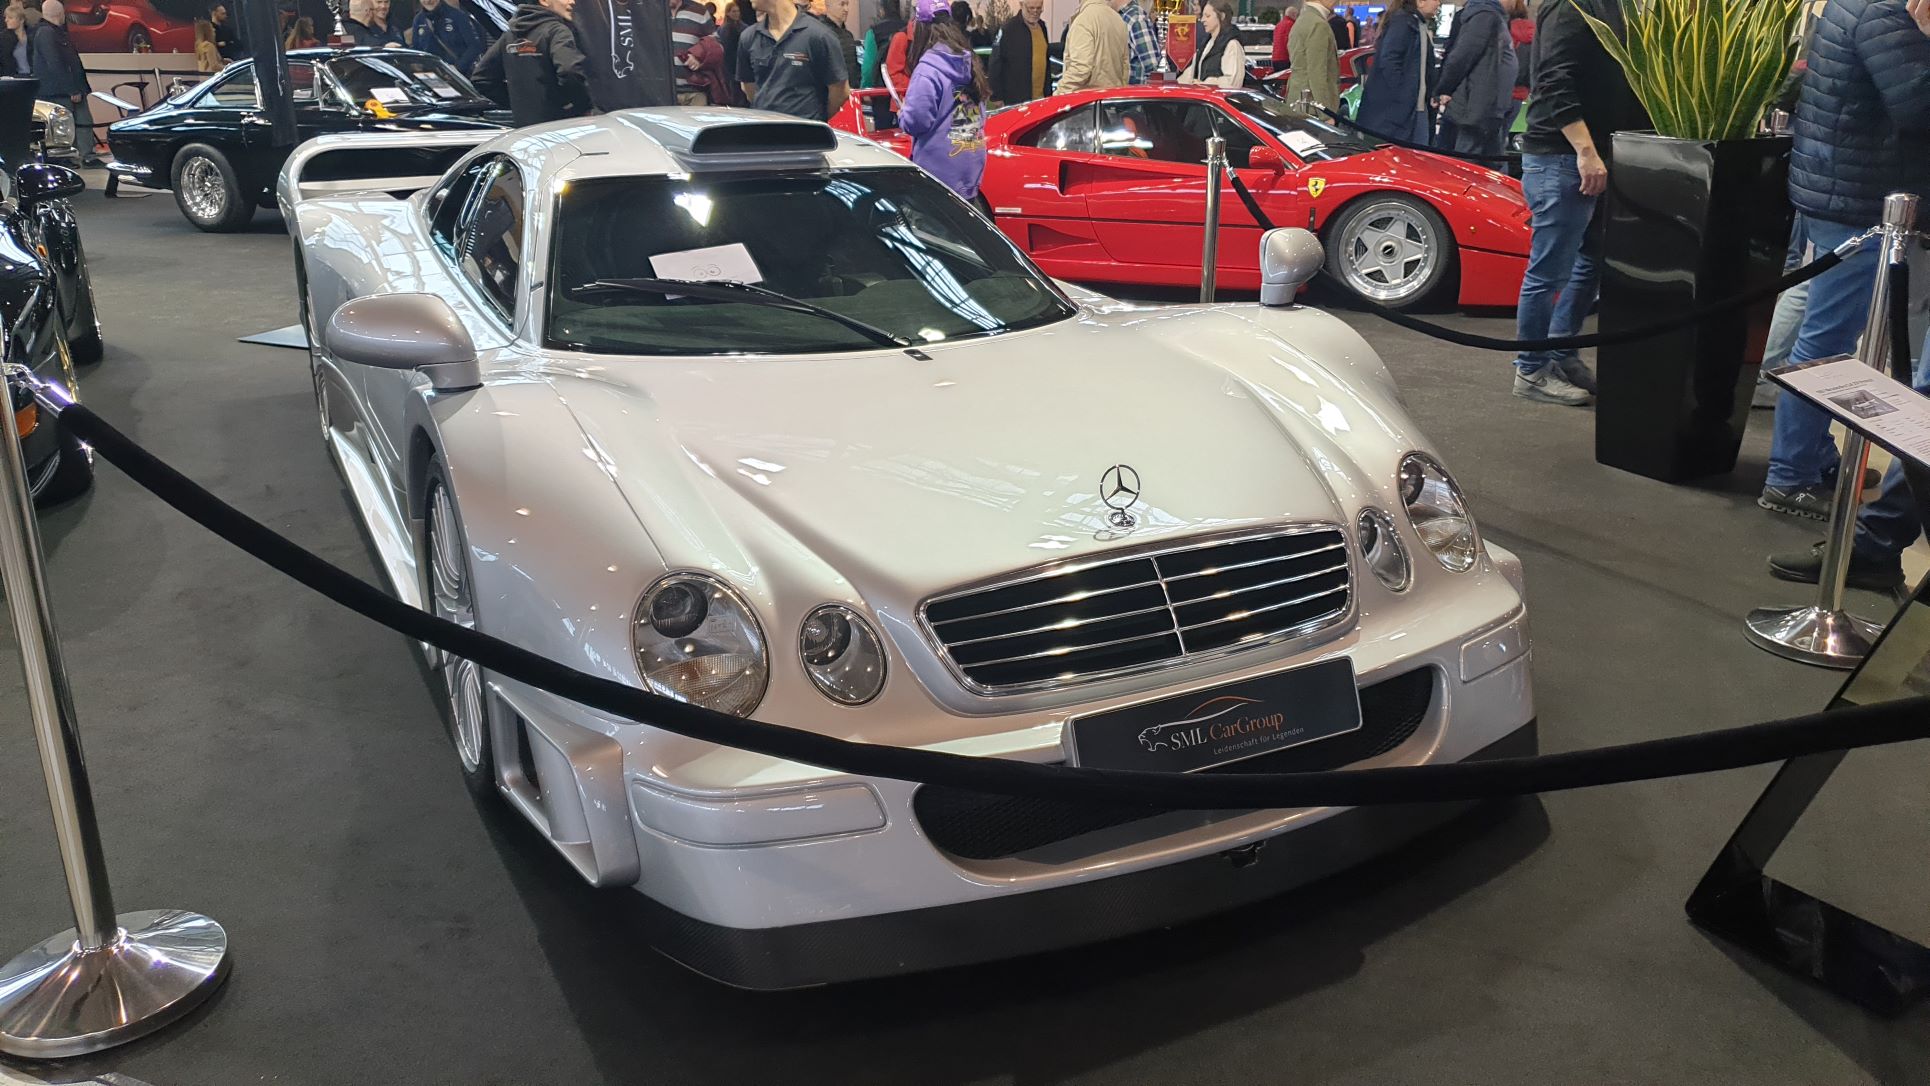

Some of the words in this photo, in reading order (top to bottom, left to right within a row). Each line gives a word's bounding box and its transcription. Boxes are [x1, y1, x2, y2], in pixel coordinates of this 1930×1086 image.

[617, 9, 634, 47] SML
[1170, 728, 1207, 751] SML
[1209, 713, 1284, 740] CarGroup
[1213, 738, 1258, 755] Leidenschaft
[1260, 734, 1270, 744] für
[1272, 727, 1304, 741] Legenden
